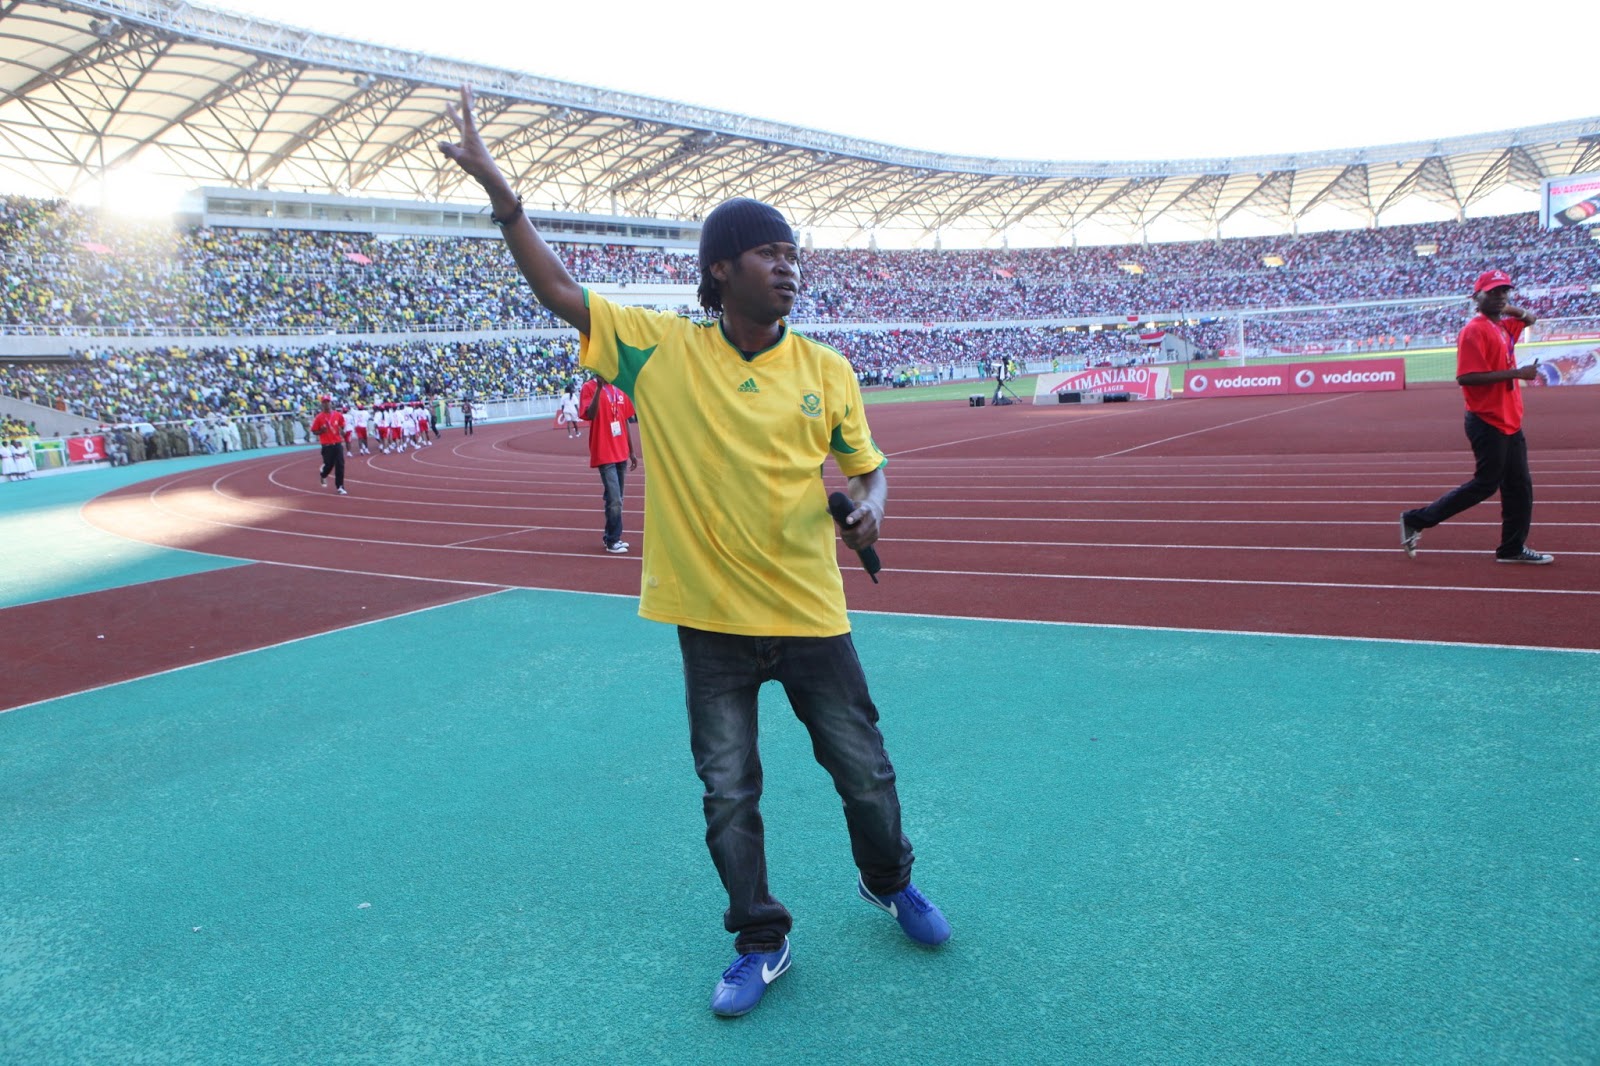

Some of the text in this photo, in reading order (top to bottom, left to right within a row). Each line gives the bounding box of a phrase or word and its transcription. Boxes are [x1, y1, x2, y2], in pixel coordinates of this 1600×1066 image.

[1056, 368, 1147, 391] LIMANJARO
[1214, 375, 1281, 388] vodacom
[1322, 370, 1395, 384] vodacom
[1103, 384, 1124, 393] LAGER
